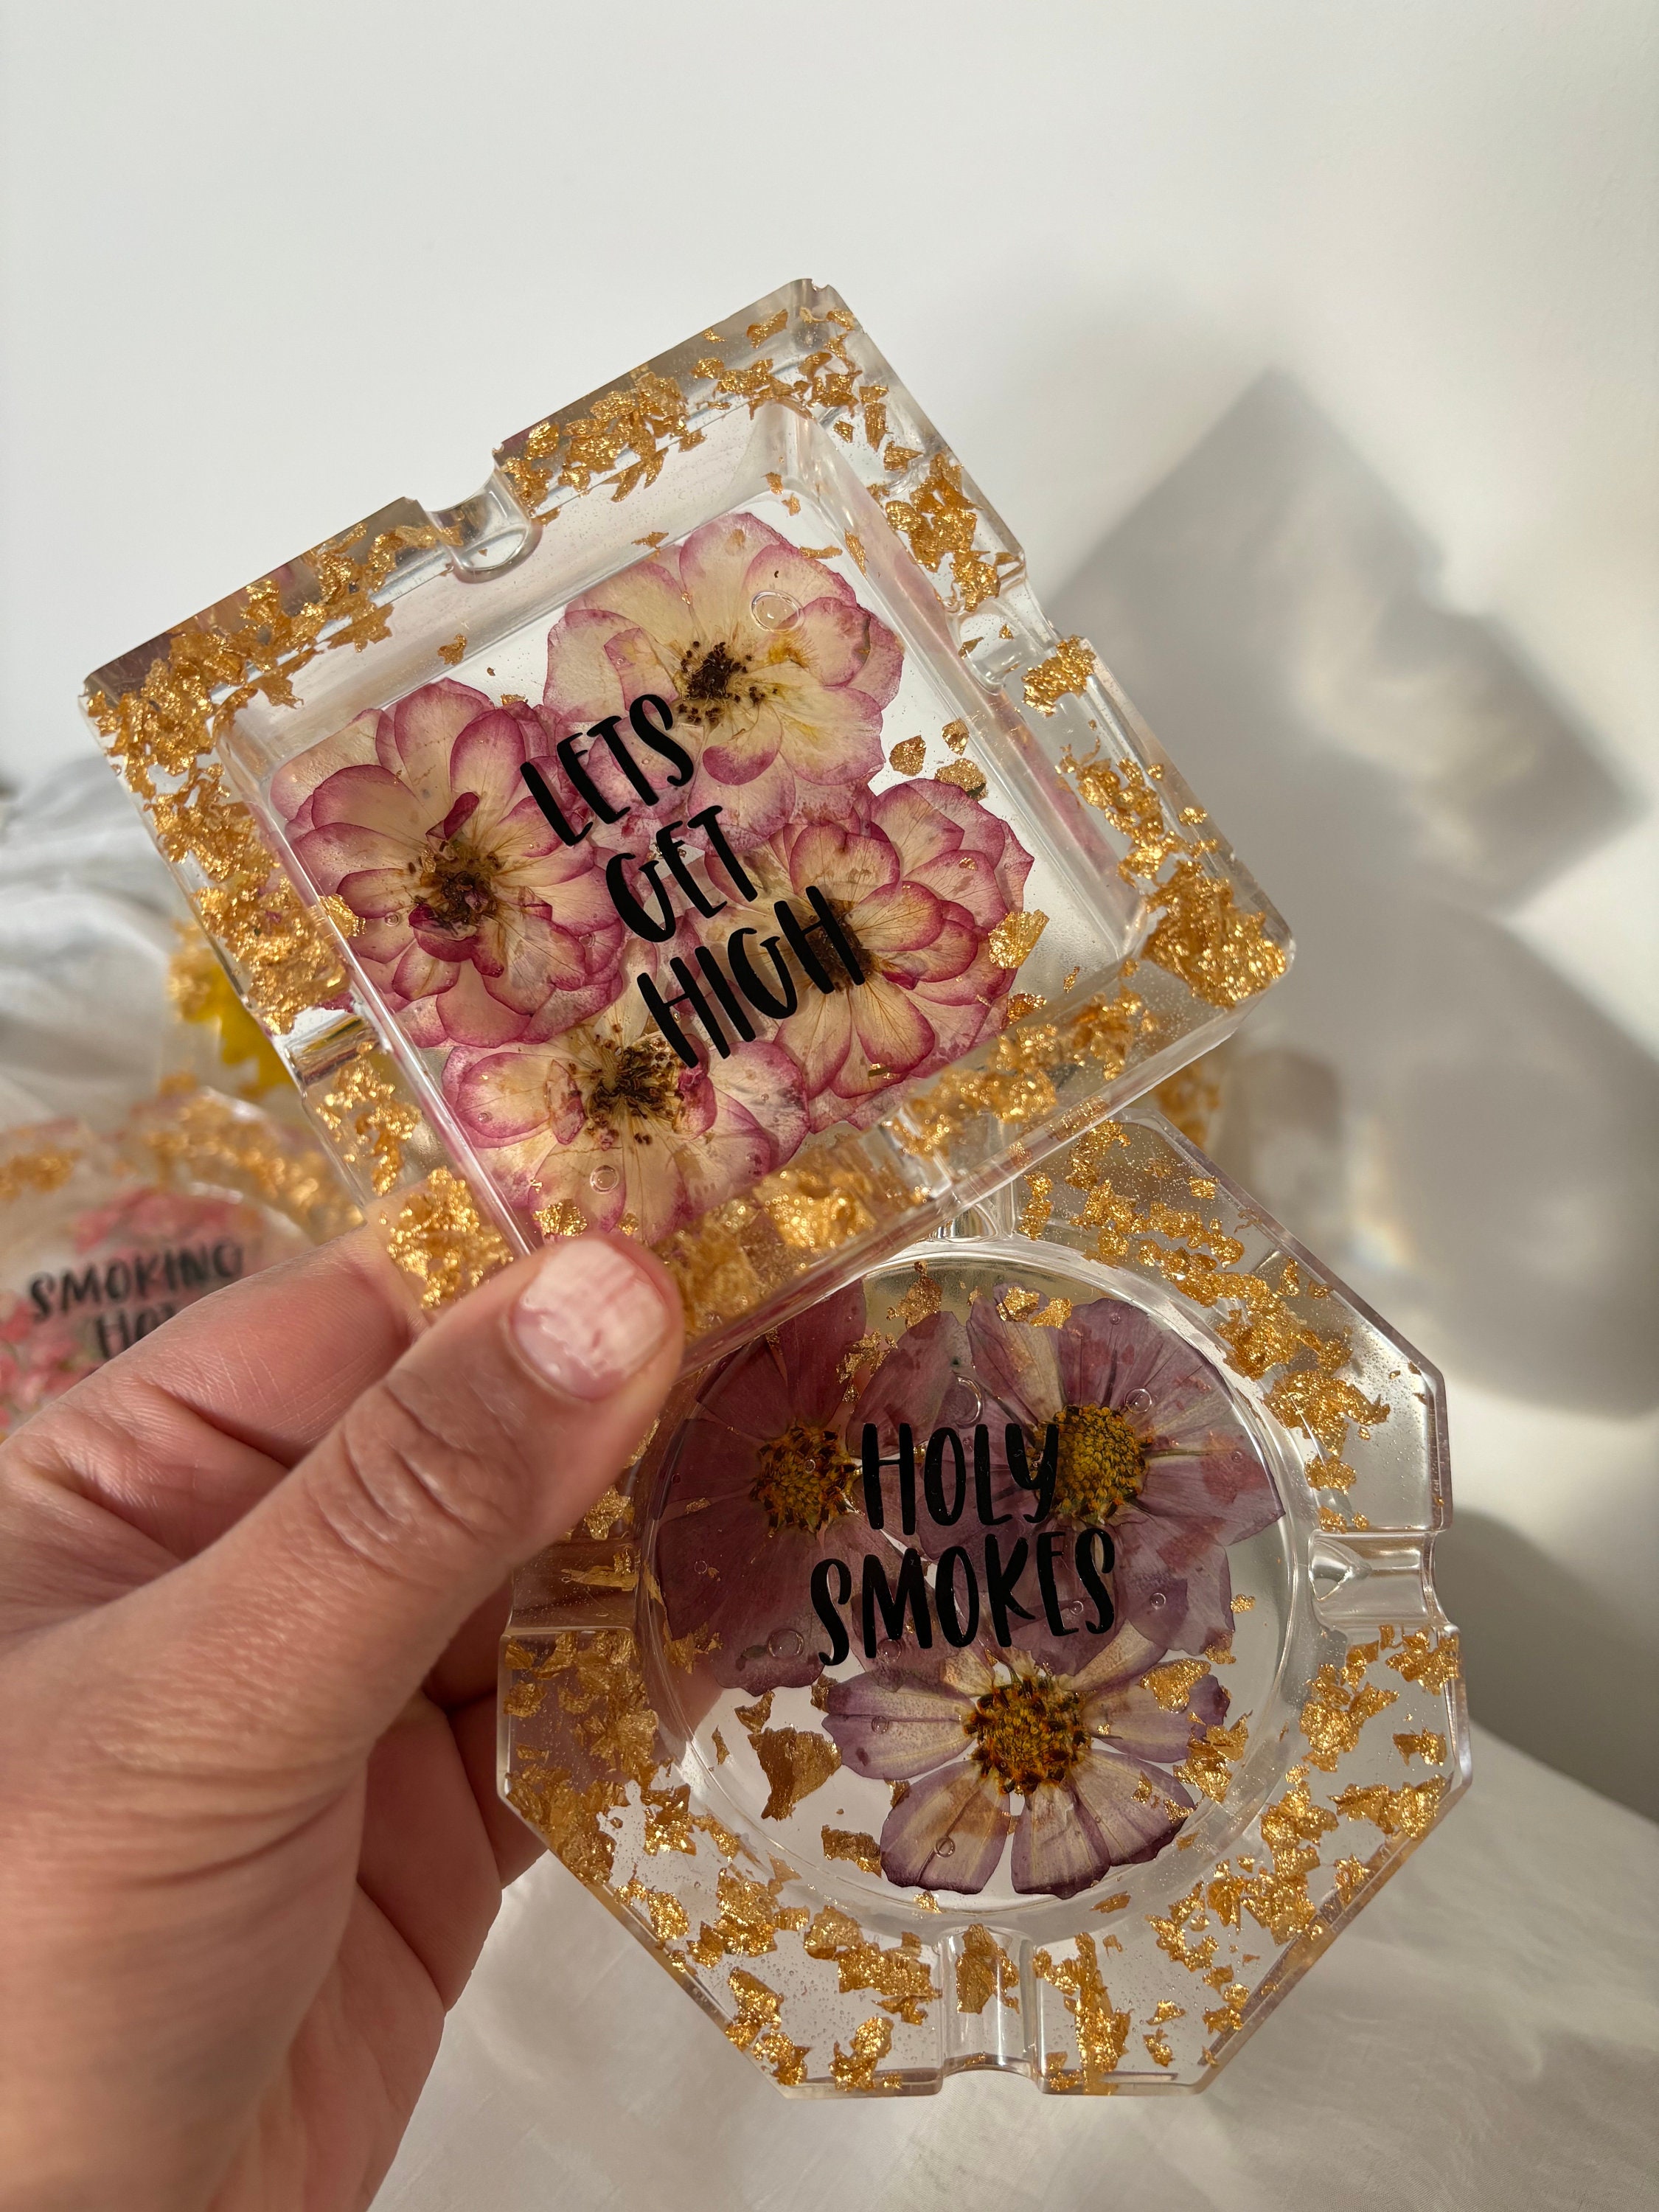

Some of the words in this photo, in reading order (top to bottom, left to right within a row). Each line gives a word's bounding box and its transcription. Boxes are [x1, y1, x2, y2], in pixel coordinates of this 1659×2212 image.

[520, 694, 694, 846] LETS
[605, 805, 757, 942] GET
[636, 886, 865, 1068] HIGH
[29, 1237, 243, 1322] SMOKING
[95, 1302, 178, 1360] HO
[862, 1422, 1059, 1535] HOLY
[811, 1528, 1115, 1666] SMOKES
